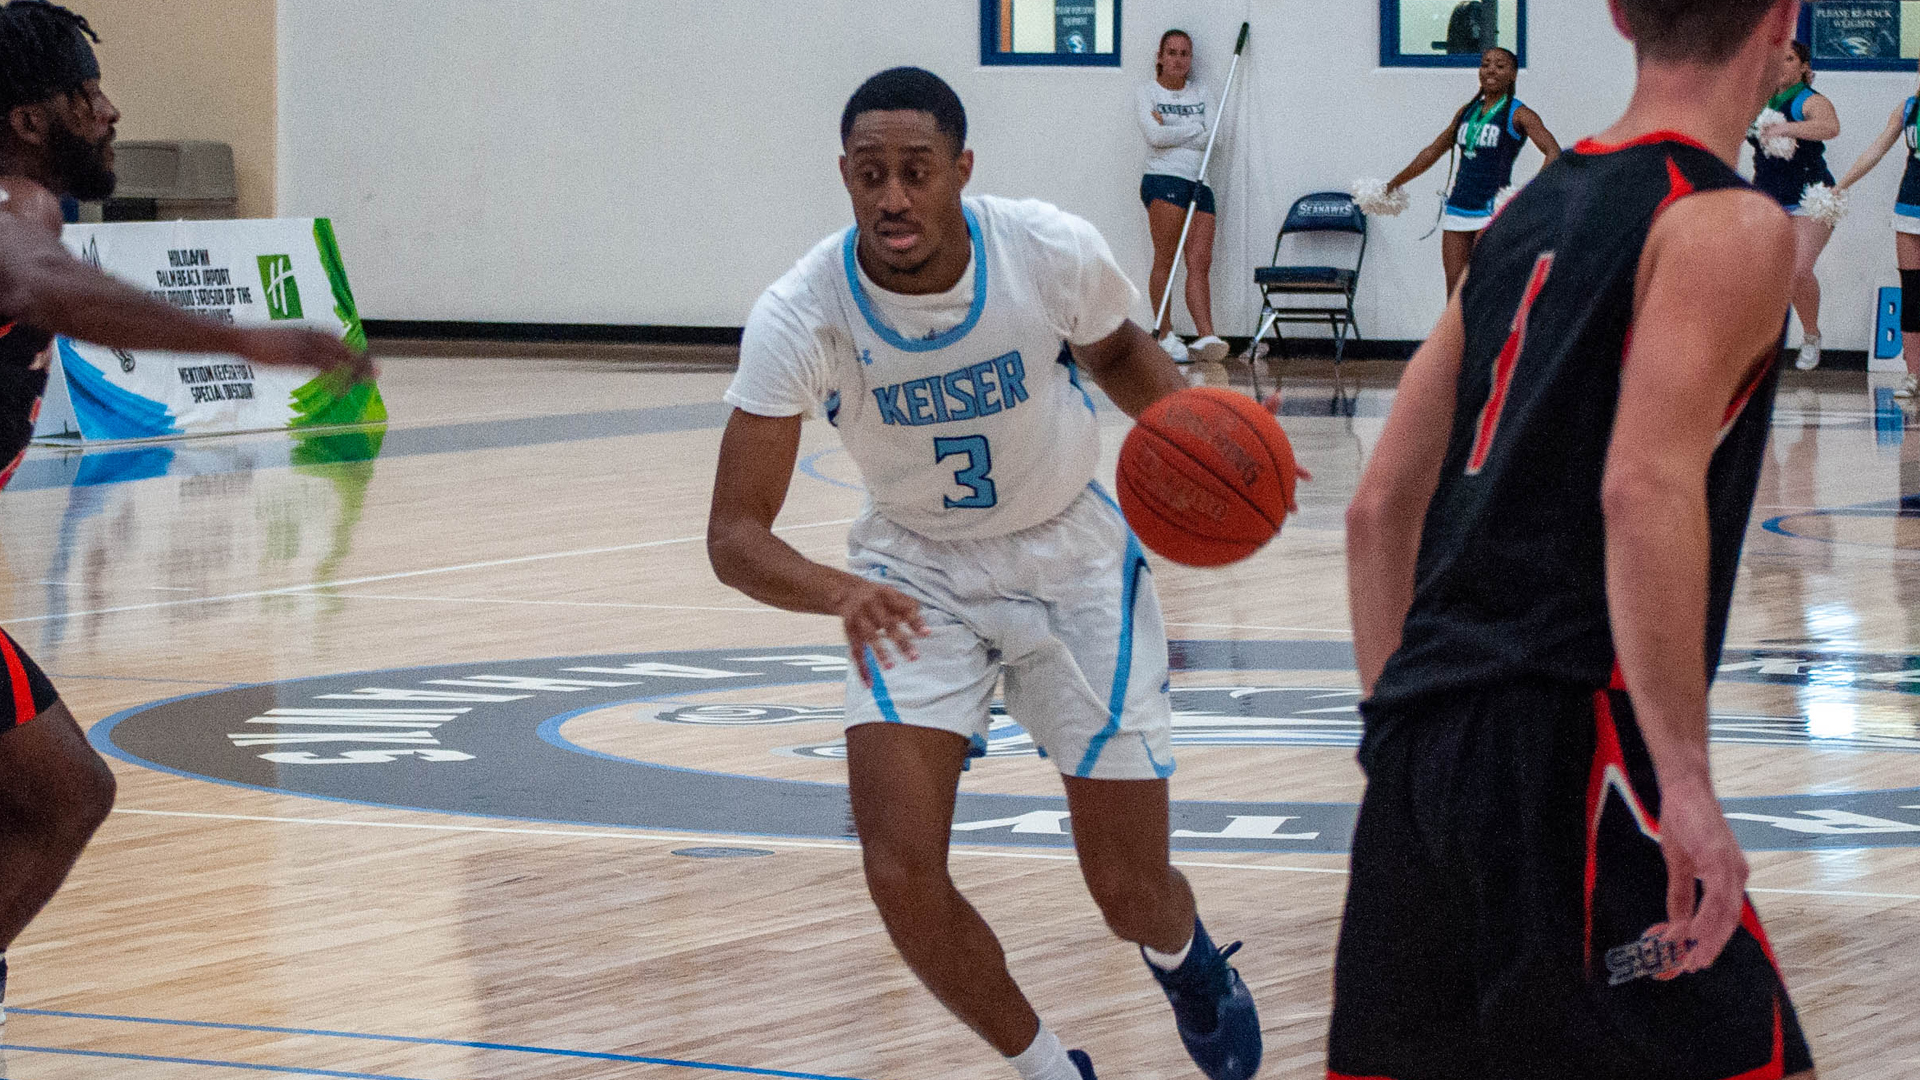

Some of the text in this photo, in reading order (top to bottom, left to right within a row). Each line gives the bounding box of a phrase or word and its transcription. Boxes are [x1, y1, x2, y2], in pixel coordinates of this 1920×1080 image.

[1816, 8, 1850, 18] PLEASE
[1299, 203, 1353, 215] SEAHAWKS
[156, 270, 178, 287] PALM
[235, 286, 253, 304] THE
[1464, 252, 1556, 476] 1
[177, 365, 215, 384] MENTION
[190, 385, 226, 404] SPECIAL
[872, 350, 1030, 427] KEISER
[933, 434, 998, 509] 3
